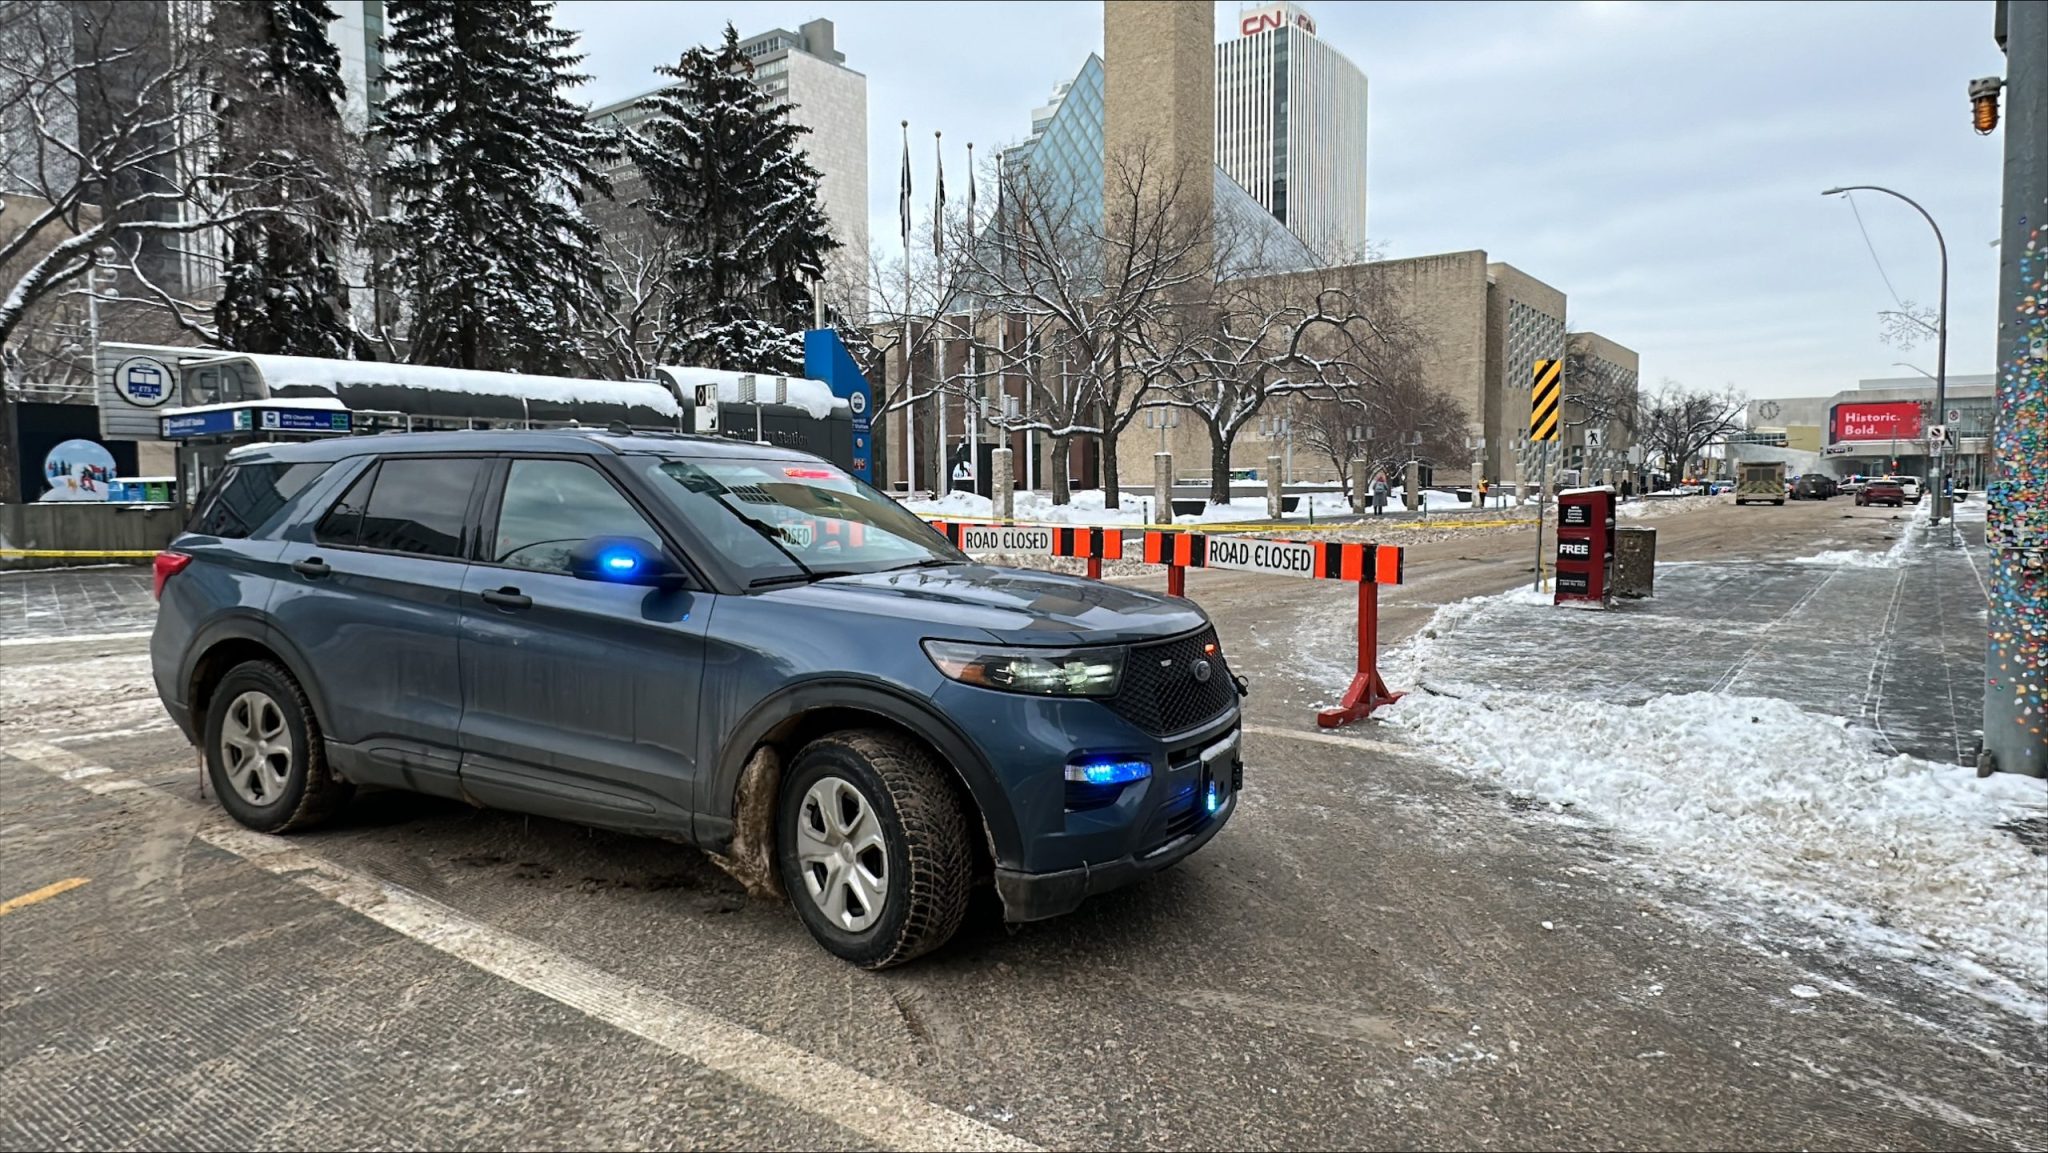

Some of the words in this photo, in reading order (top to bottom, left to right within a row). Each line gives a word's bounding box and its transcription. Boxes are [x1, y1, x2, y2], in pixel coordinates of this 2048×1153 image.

[1243, 10, 1281, 36] CN
[1845, 412, 1901, 422] Historic.
[1845, 424, 1878, 435] Bold.
[966, 532, 998, 549] ROAD
[1003, 532, 1048, 549] CLOSED
[1209, 540, 1249, 565] ROAD
[1254, 544, 1311, 571] CLOSED
[1559, 544, 1589, 555] FREE
